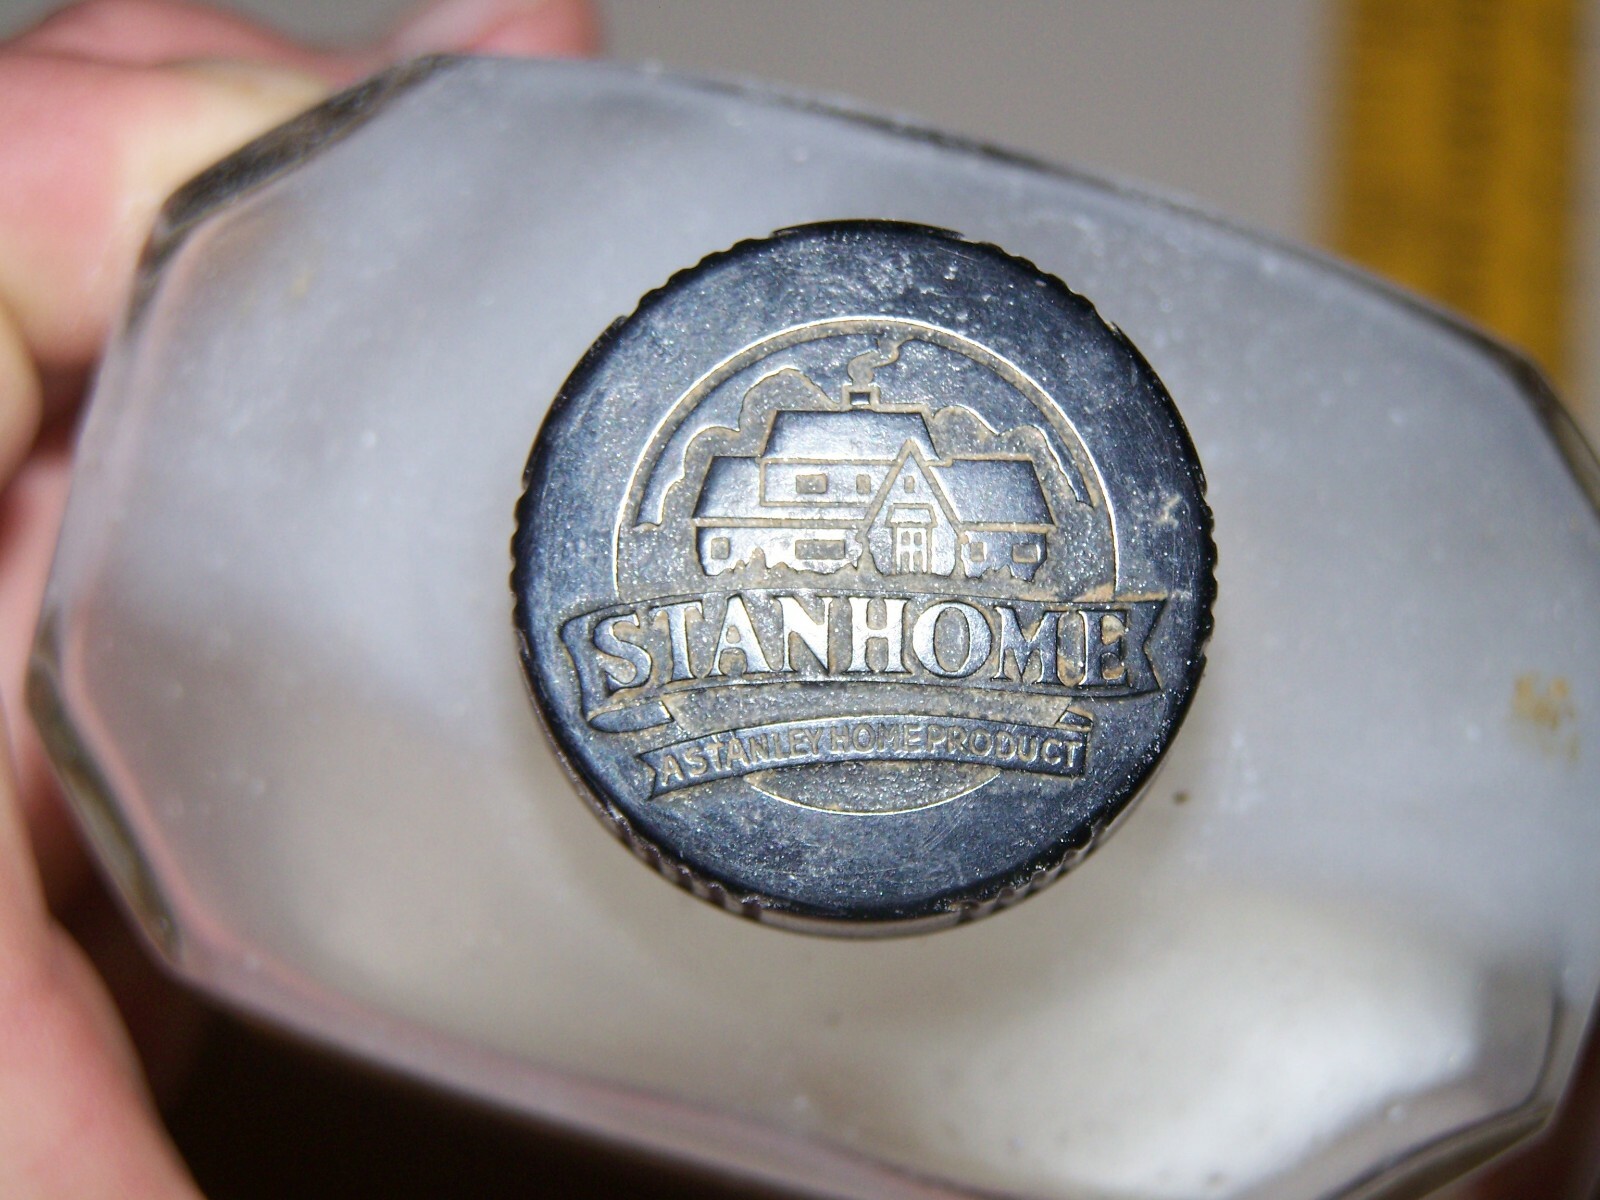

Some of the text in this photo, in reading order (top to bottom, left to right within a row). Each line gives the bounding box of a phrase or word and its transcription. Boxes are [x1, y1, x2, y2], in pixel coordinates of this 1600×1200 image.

[592, 595, 1131, 694] STANHOME
[684, 729, 823, 779] STANLEY
[828, 722, 921, 755] HOME
[926, 728, 1085, 768] PRODUCT
